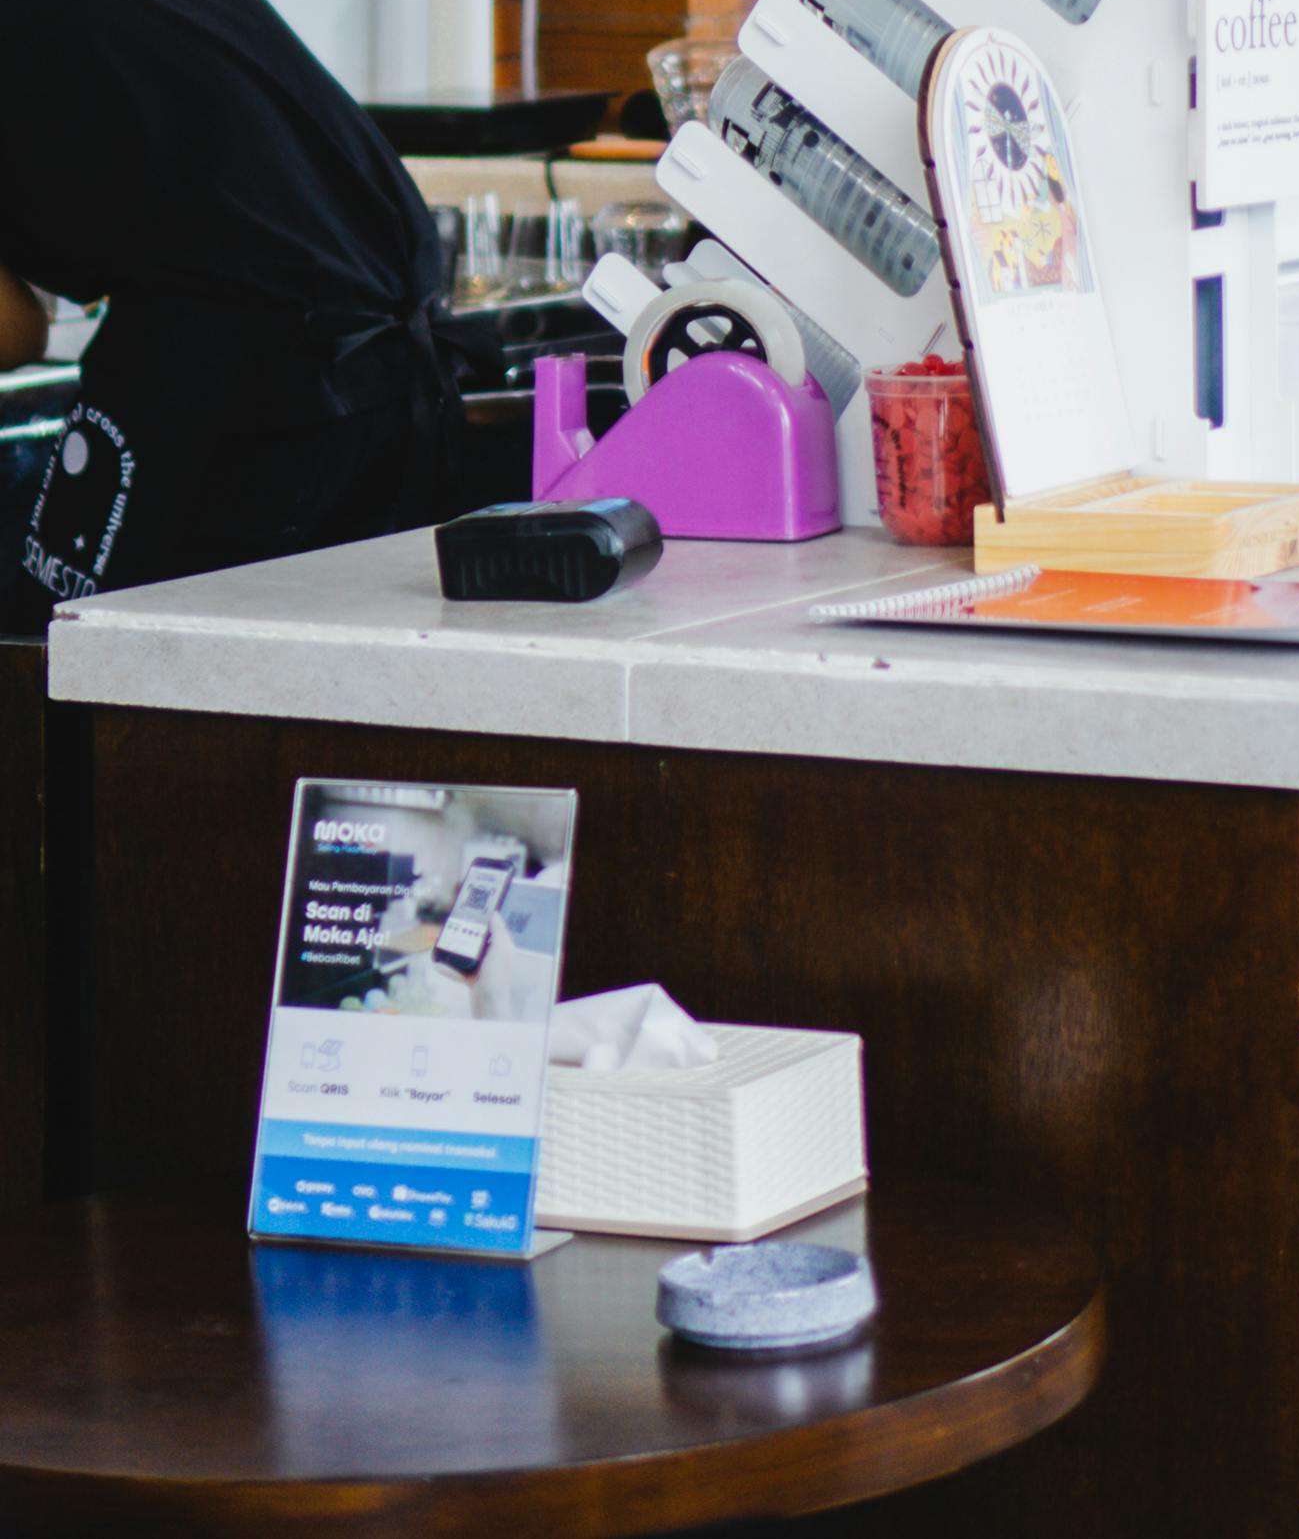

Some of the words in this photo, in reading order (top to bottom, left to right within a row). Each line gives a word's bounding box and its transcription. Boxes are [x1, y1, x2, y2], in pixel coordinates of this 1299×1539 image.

[86, 407, 125, 448] cross
[120, 450, 135, 488] the
[92, 493, 128, 576] universe
[308, 880, 330, 892] Mau
[332, 881, 393, 896] Pembayaran
[305, 901, 350, 920] Scan
[353, 903, 372, 922] di
[303, 924, 353, 943] Moka
[288, 1080, 317, 1093] Scan
[320, 1083, 349, 1096] QRIS
[379, 1086, 400, 1099] Klik
